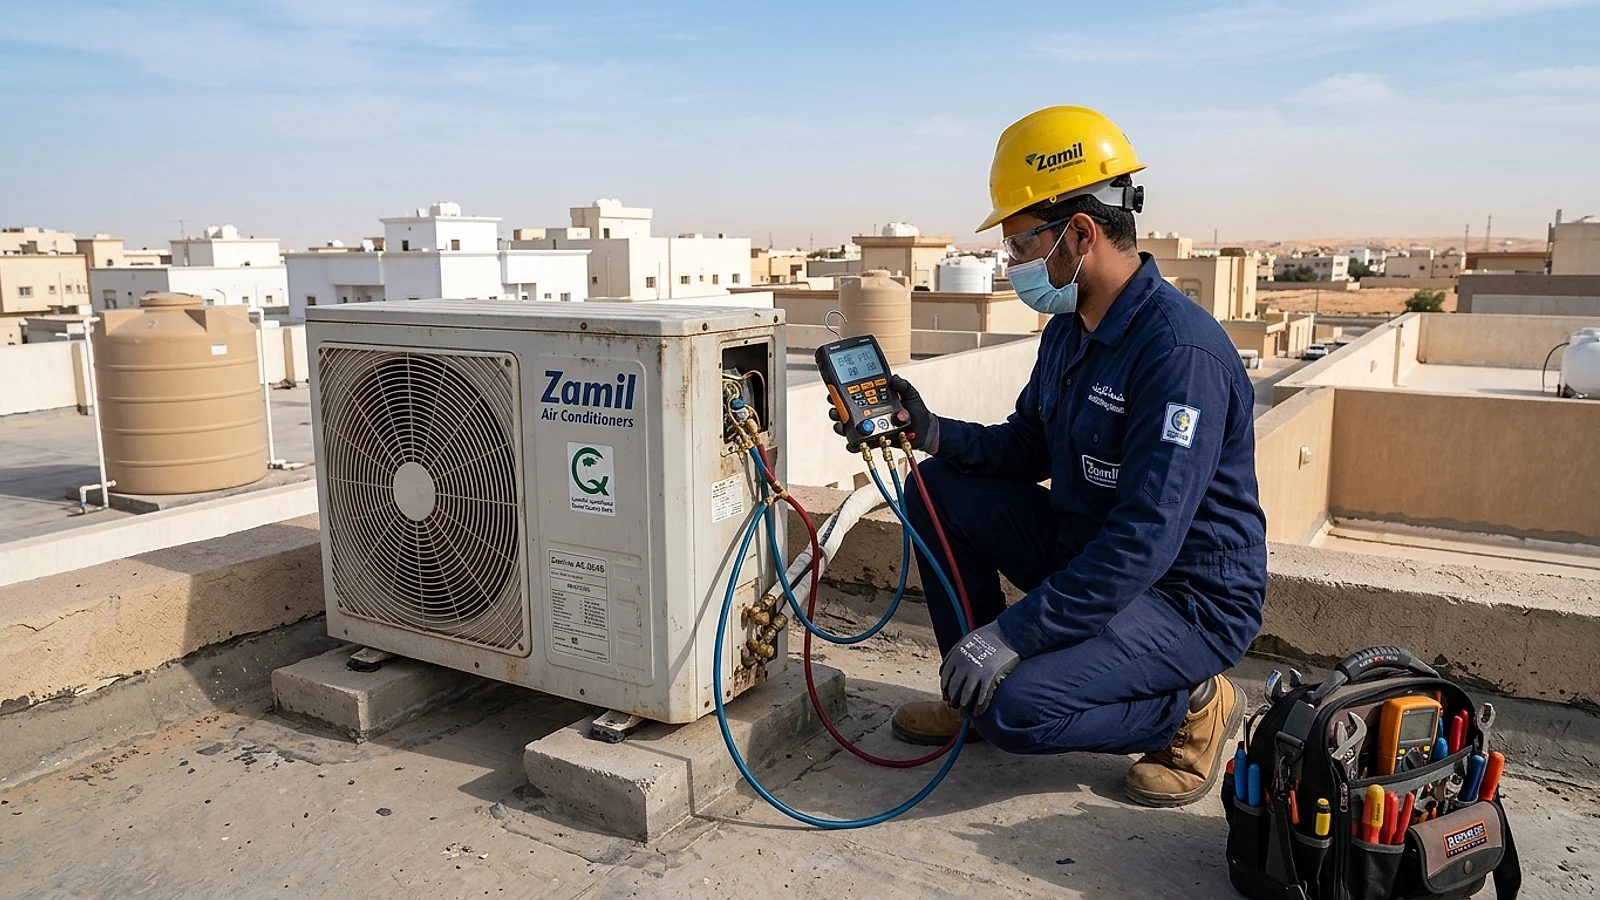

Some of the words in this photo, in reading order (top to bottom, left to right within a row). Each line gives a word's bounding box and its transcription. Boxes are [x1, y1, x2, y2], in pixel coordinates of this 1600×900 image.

[1036, 142, 1083, 171] Zamil
[540, 370, 637, 409] Zamil
[541, 407, 558, 421] Air
[561, 409, 634, 428] Conditioners
